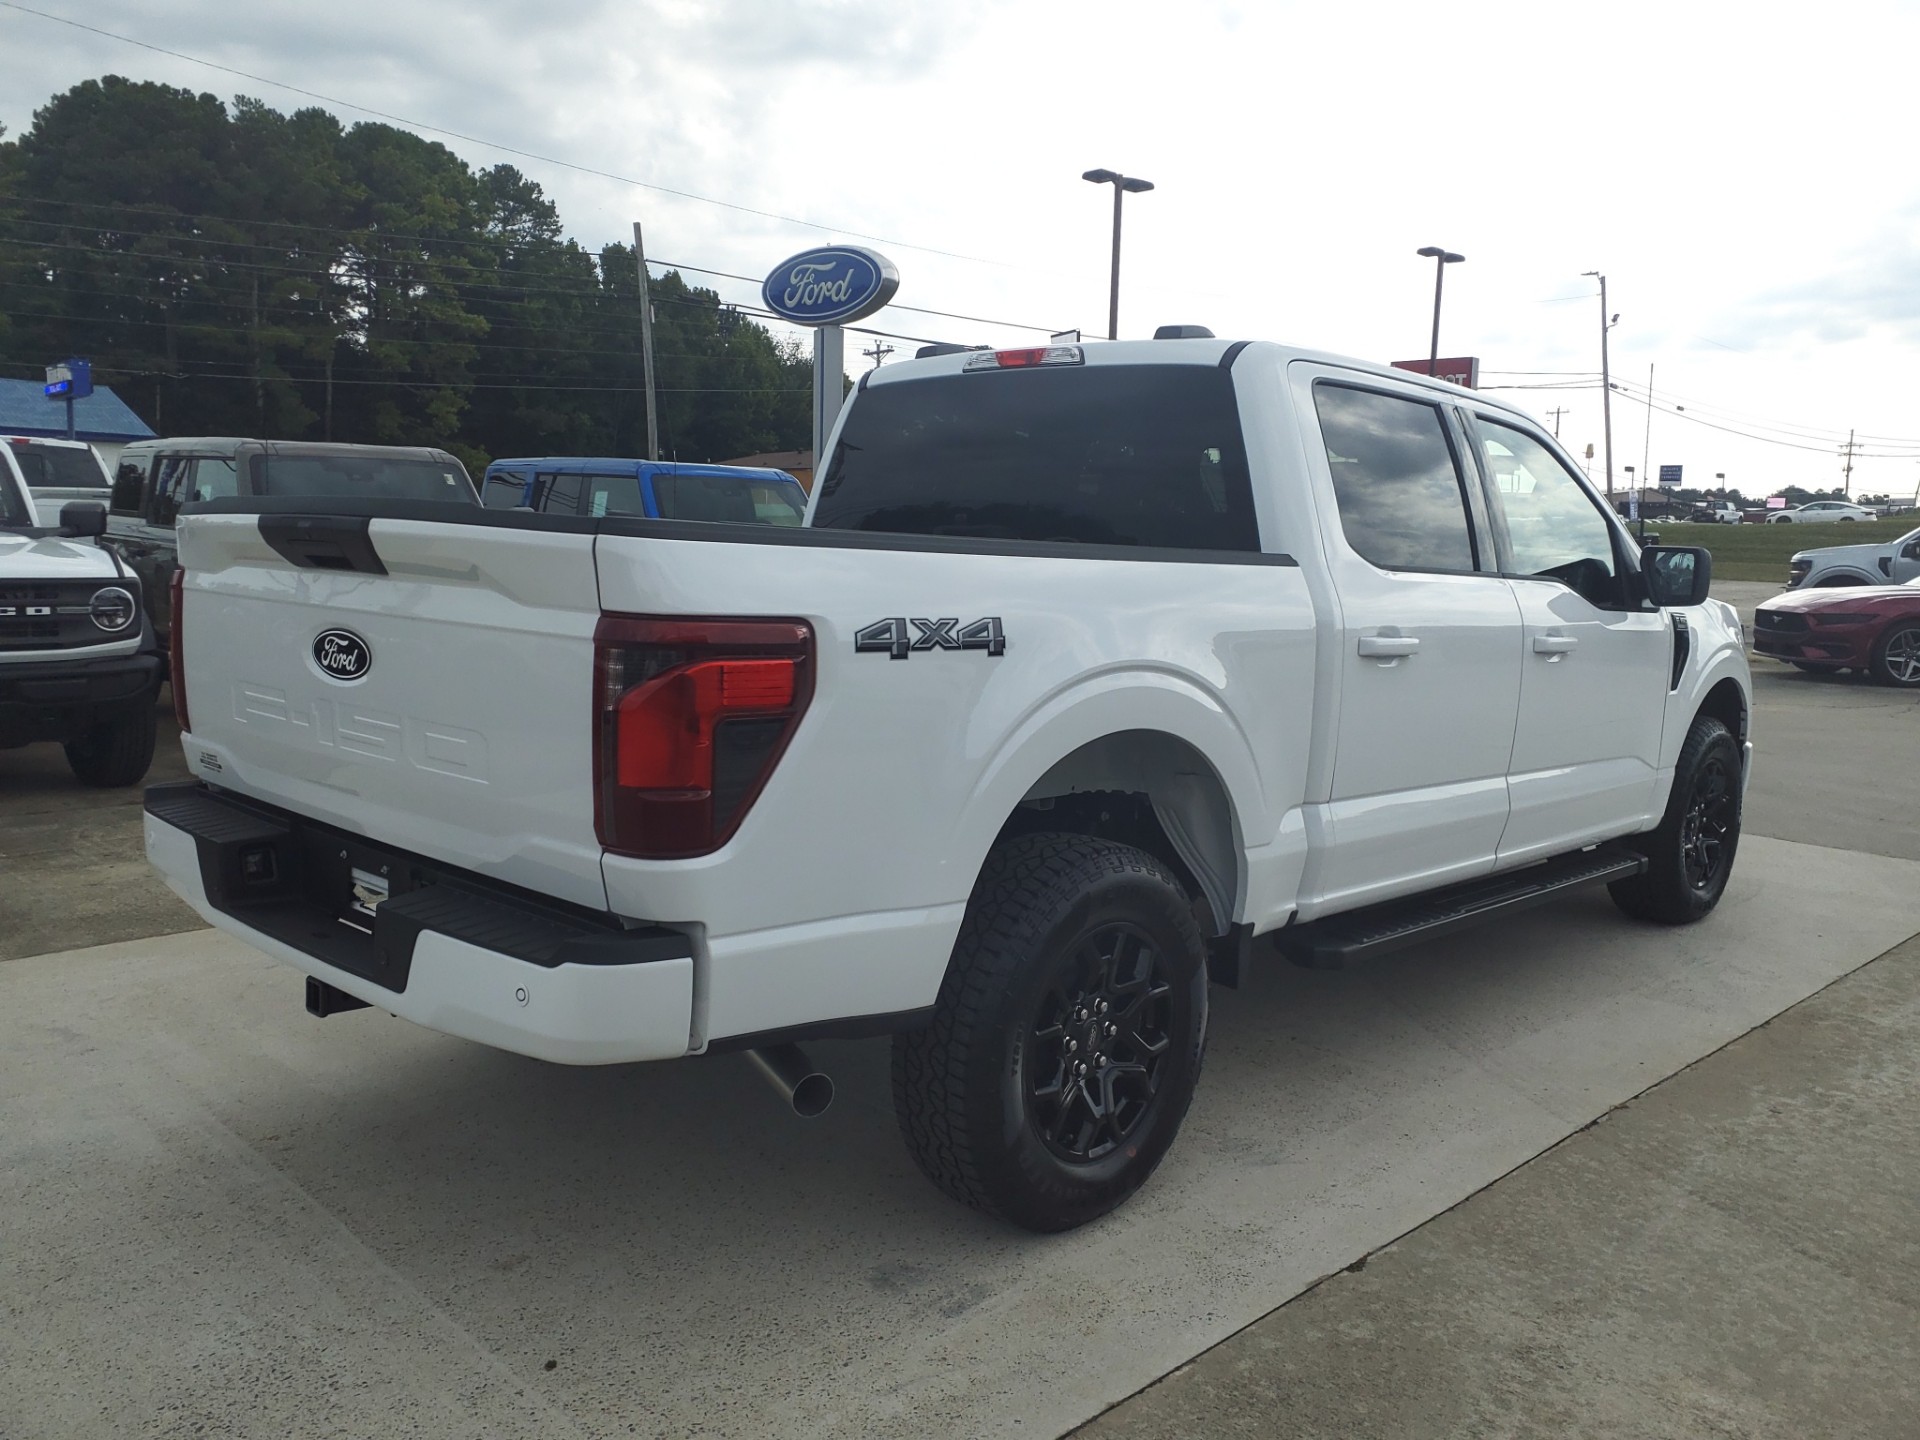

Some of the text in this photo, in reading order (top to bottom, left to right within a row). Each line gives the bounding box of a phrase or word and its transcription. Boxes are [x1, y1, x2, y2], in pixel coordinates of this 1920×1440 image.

[784, 261, 854, 308] Ford
[321, 636, 359, 672] Ford
[231, 679, 489, 784] F-150
